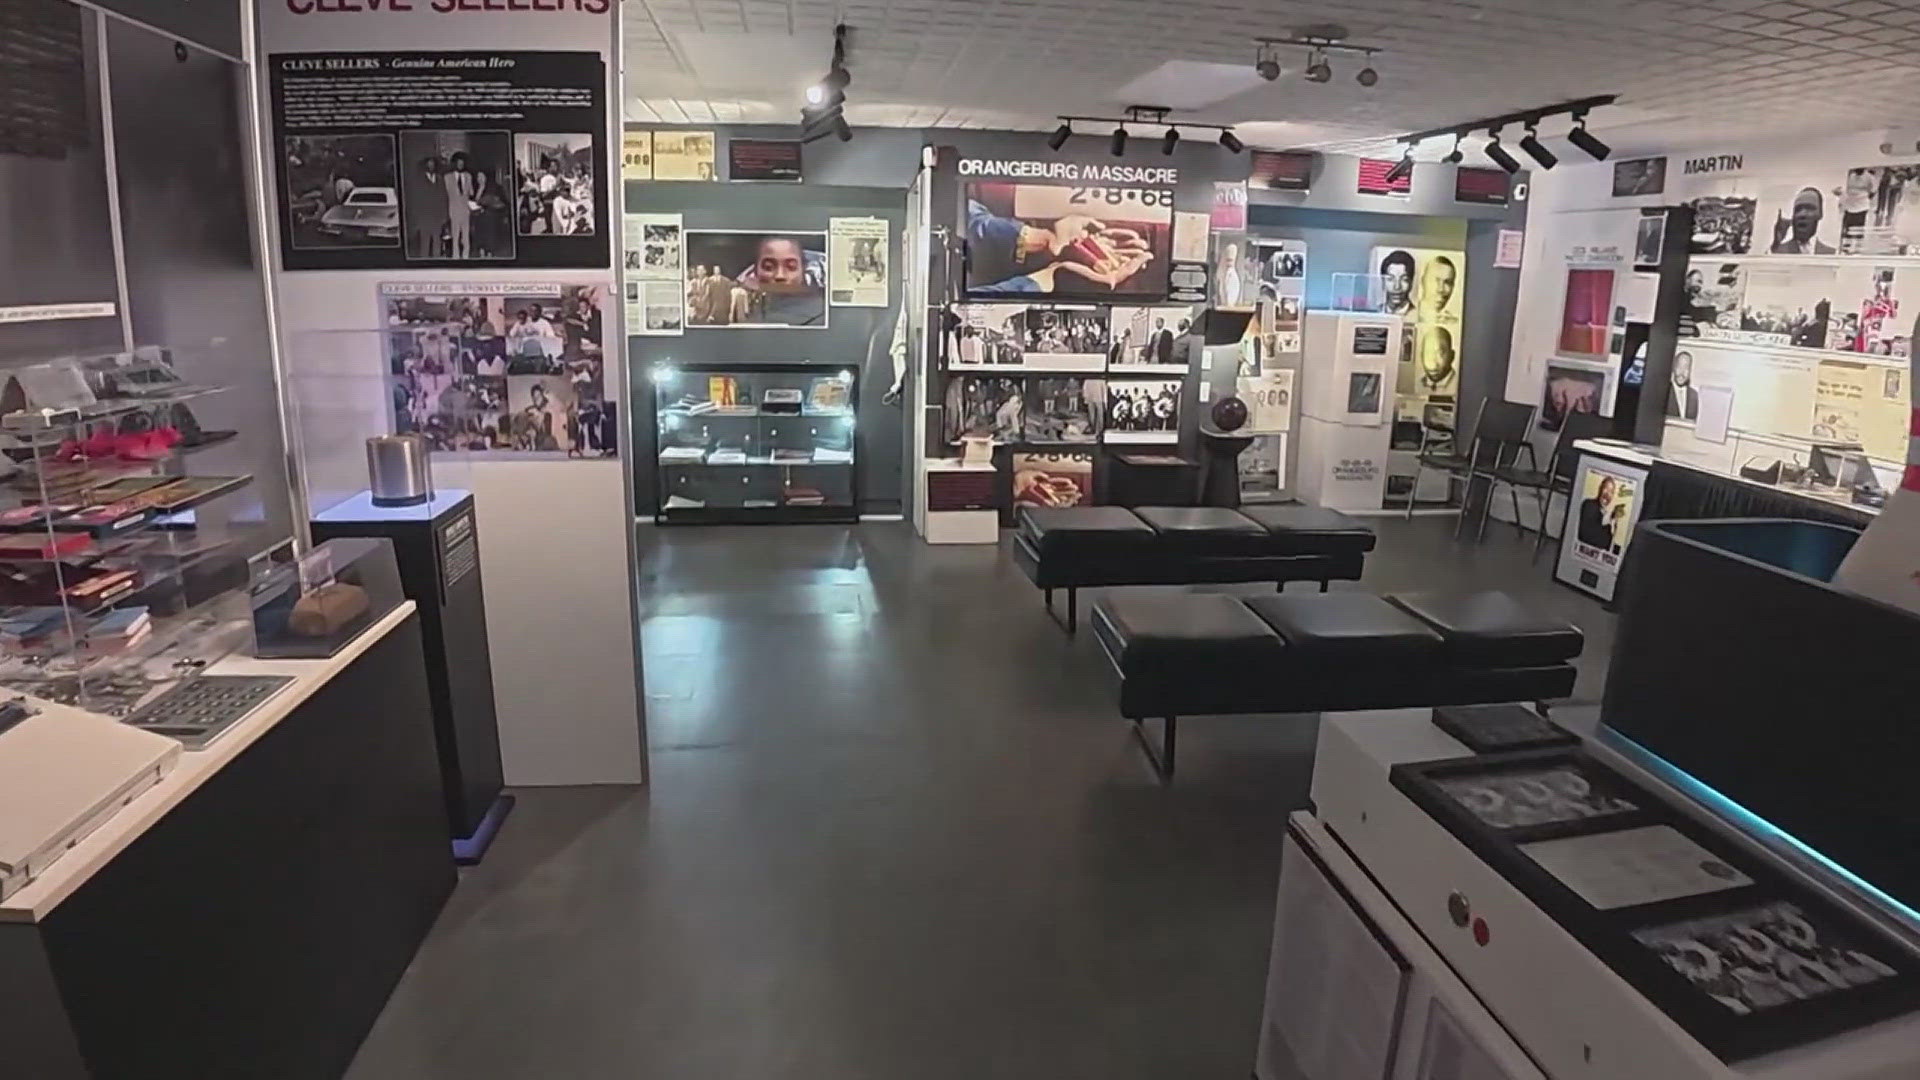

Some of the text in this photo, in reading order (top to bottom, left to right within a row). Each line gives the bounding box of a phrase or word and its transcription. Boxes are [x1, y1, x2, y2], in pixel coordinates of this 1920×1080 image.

[282, 59, 322, 71] CLEVE
[325, 58, 380, 70] SELLERS
[436, 57, 487, 68] American
[489, 56, 516, 68] Hero
[958, 159, 1178, 184] ORANGEBURG MASSACRE
[1684, 154, 1744, 175] MARTIN
